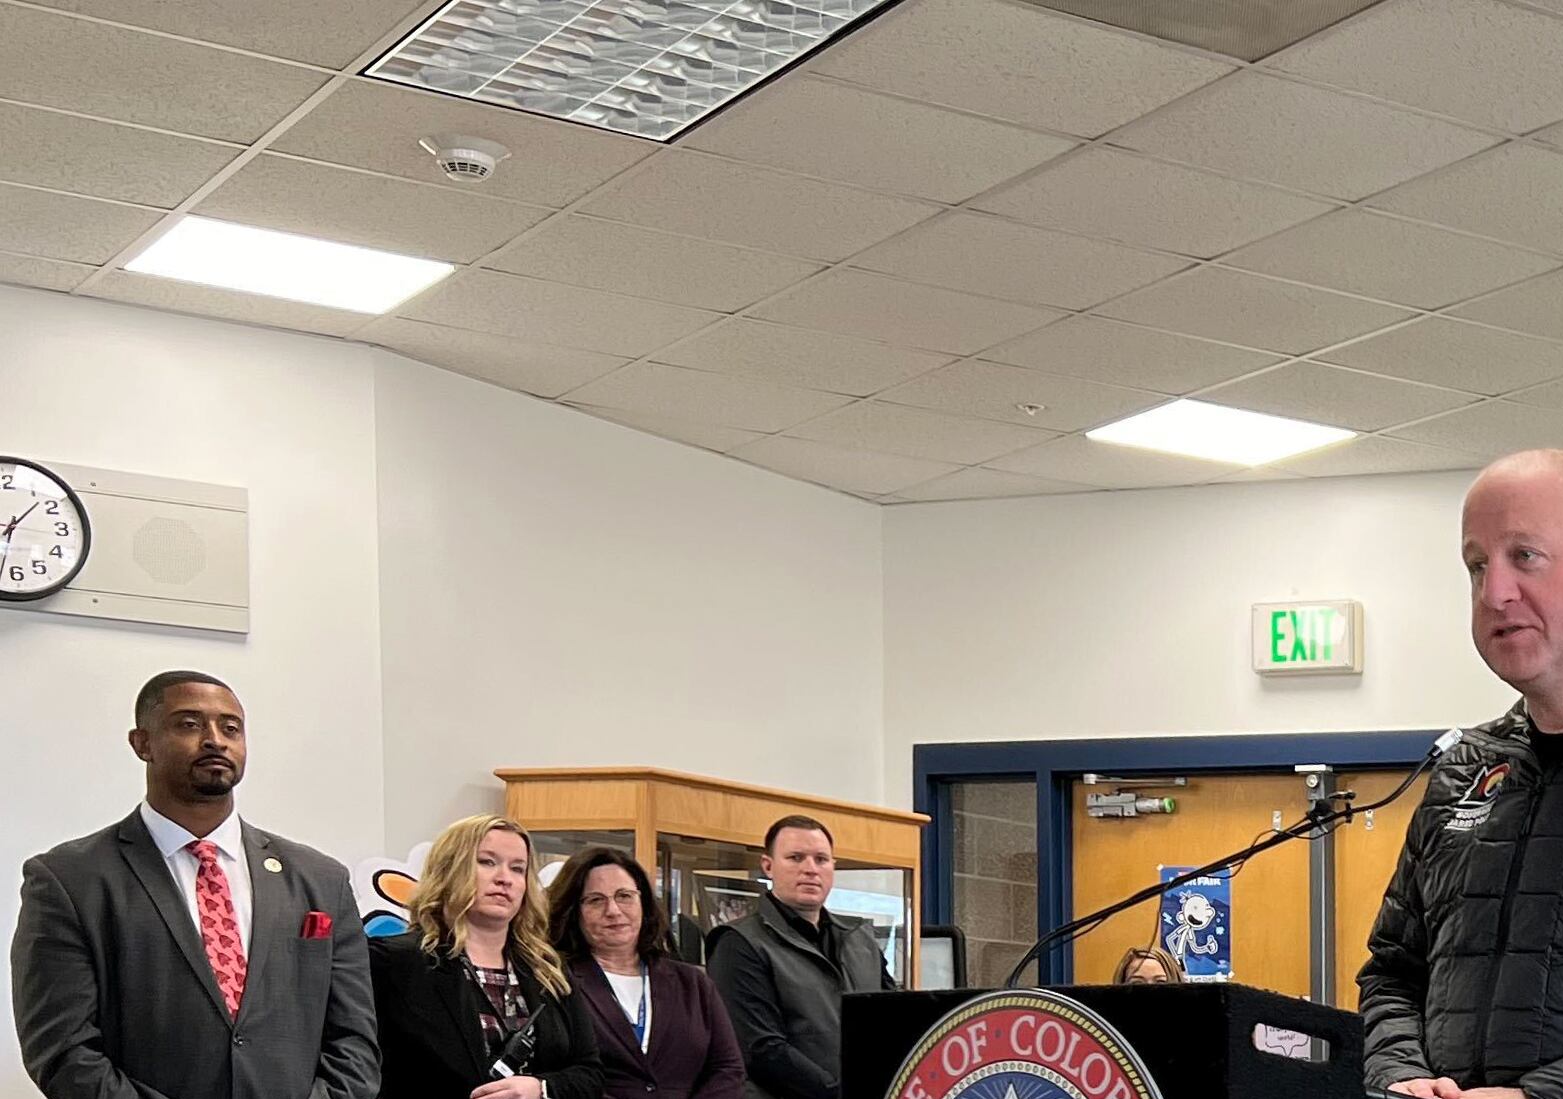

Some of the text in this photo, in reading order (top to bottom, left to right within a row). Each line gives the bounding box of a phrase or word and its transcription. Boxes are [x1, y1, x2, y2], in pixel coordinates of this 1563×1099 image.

[0, 475, 16, 490] 2
[44, 500, 60, 515] 2
[54, 522, 70, 537] 3
[48, 544, 63, 559] 4
[9, 566, 25, 581] 6
[31, 560, 47, 575] 5
[1271, 610, 1336, 662] EXIT
[941, 1021, 989, 1078] OF
